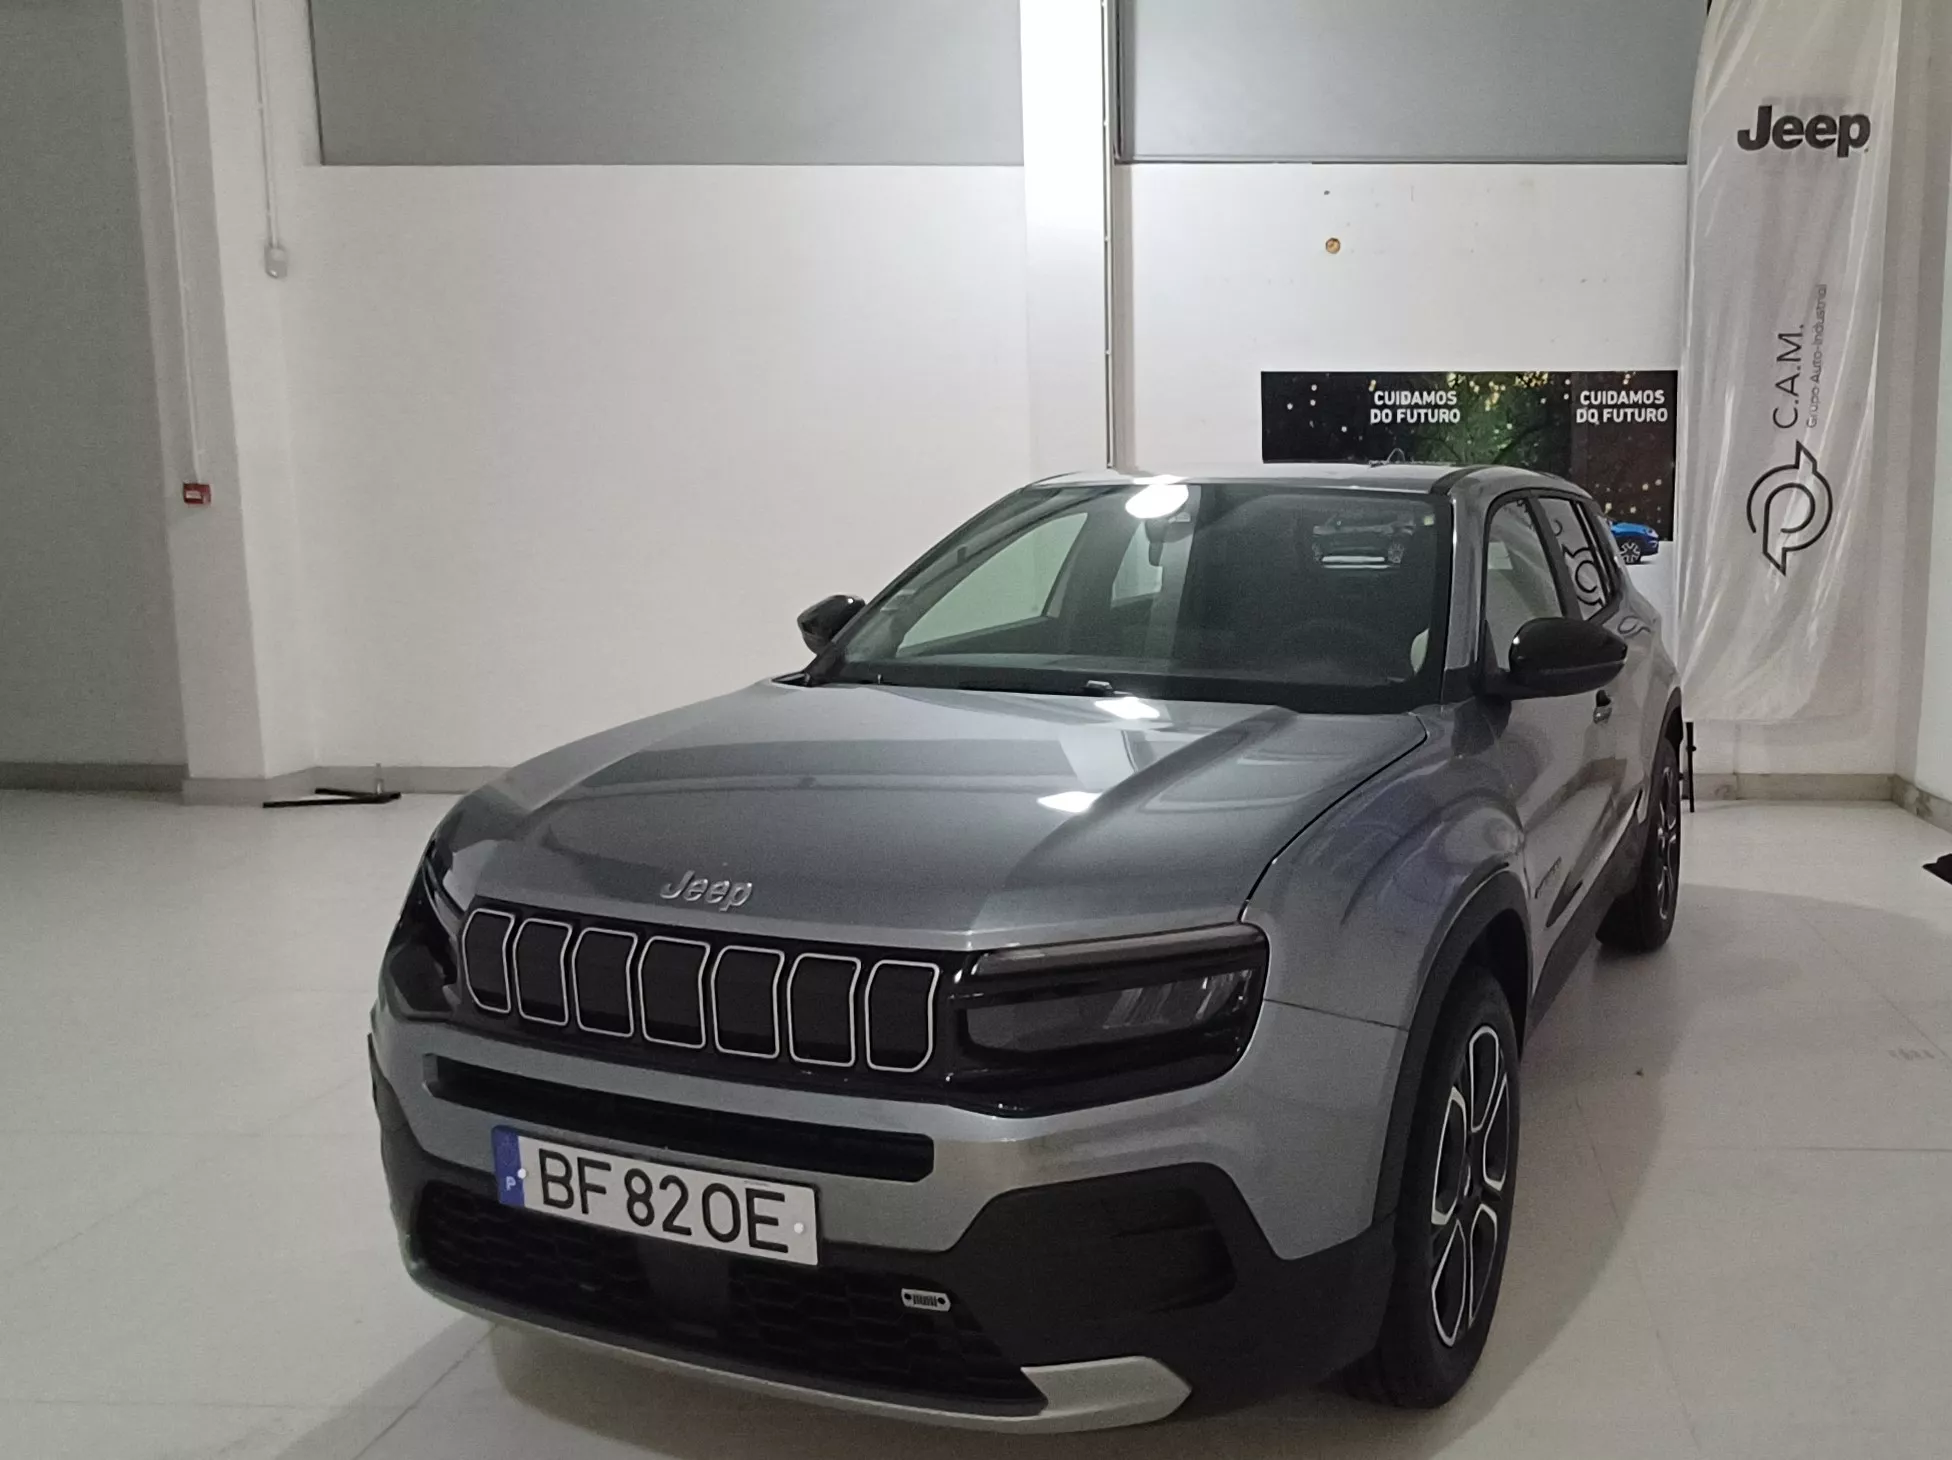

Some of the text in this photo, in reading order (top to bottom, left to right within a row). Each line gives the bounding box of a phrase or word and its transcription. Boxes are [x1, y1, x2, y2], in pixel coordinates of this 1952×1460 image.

[1737, 104, 1871, 158] Jeep
[1773, 323, 1806, 429] C.A.M.
[1373, 390, 1458, 406] CUIDAMOS
[1579, 389, 1666, 406] CUIDAMOS
[1370, 408, 1461, 424] DO FUTURO
[1603, 407, 1669, 423] FUTURO
[659, 870, 753, 912] Jeep
[505, 1176, 517, 1192] P
